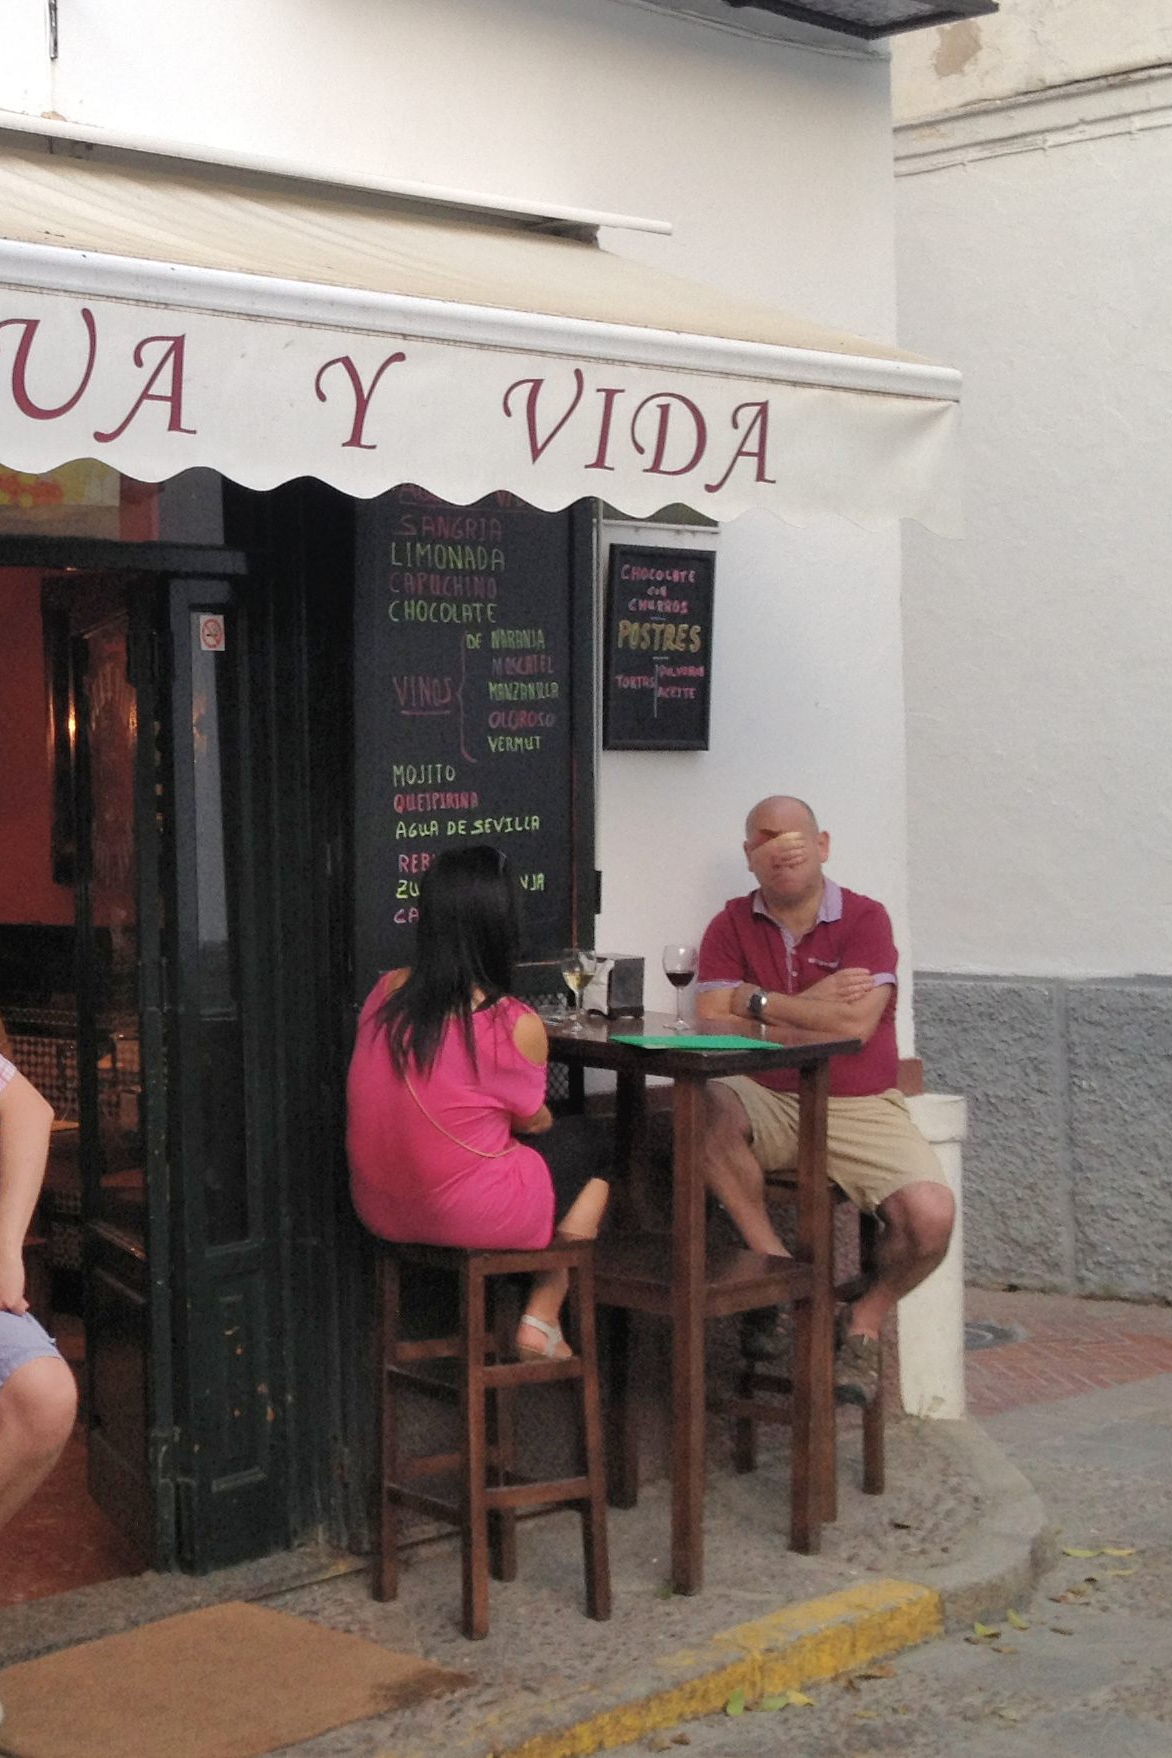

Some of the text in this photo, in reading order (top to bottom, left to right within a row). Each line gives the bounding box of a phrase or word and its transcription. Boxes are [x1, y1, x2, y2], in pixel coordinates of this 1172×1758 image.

[314, 352, 406, 449] Y
[503, 368, 776, 494] VIDA
[392, 513, 503, 542] SANGRIA
[391, 541, 506, 572] LIMONADA
[389, 571, 498, 600] CAPUCHINO
[620, 564, 696, 584] CHOCOLATE
[388, 600, 498, 624] CHOCOLATE
[628, 598, 689, 614] CHURROS
[465, 628, 546, 649] DE NARANJA
[617, 619, 702, 653] POSTRES
[392, 675, 452, 707] VINOS
[488, 681, 560, 701] MANZANILLA
[487, 734, 542, 754] VERMUT
[393, 763, 456, 787] MOJITO
[395, 815, 541, 840] AGUA DE SEVILLA
